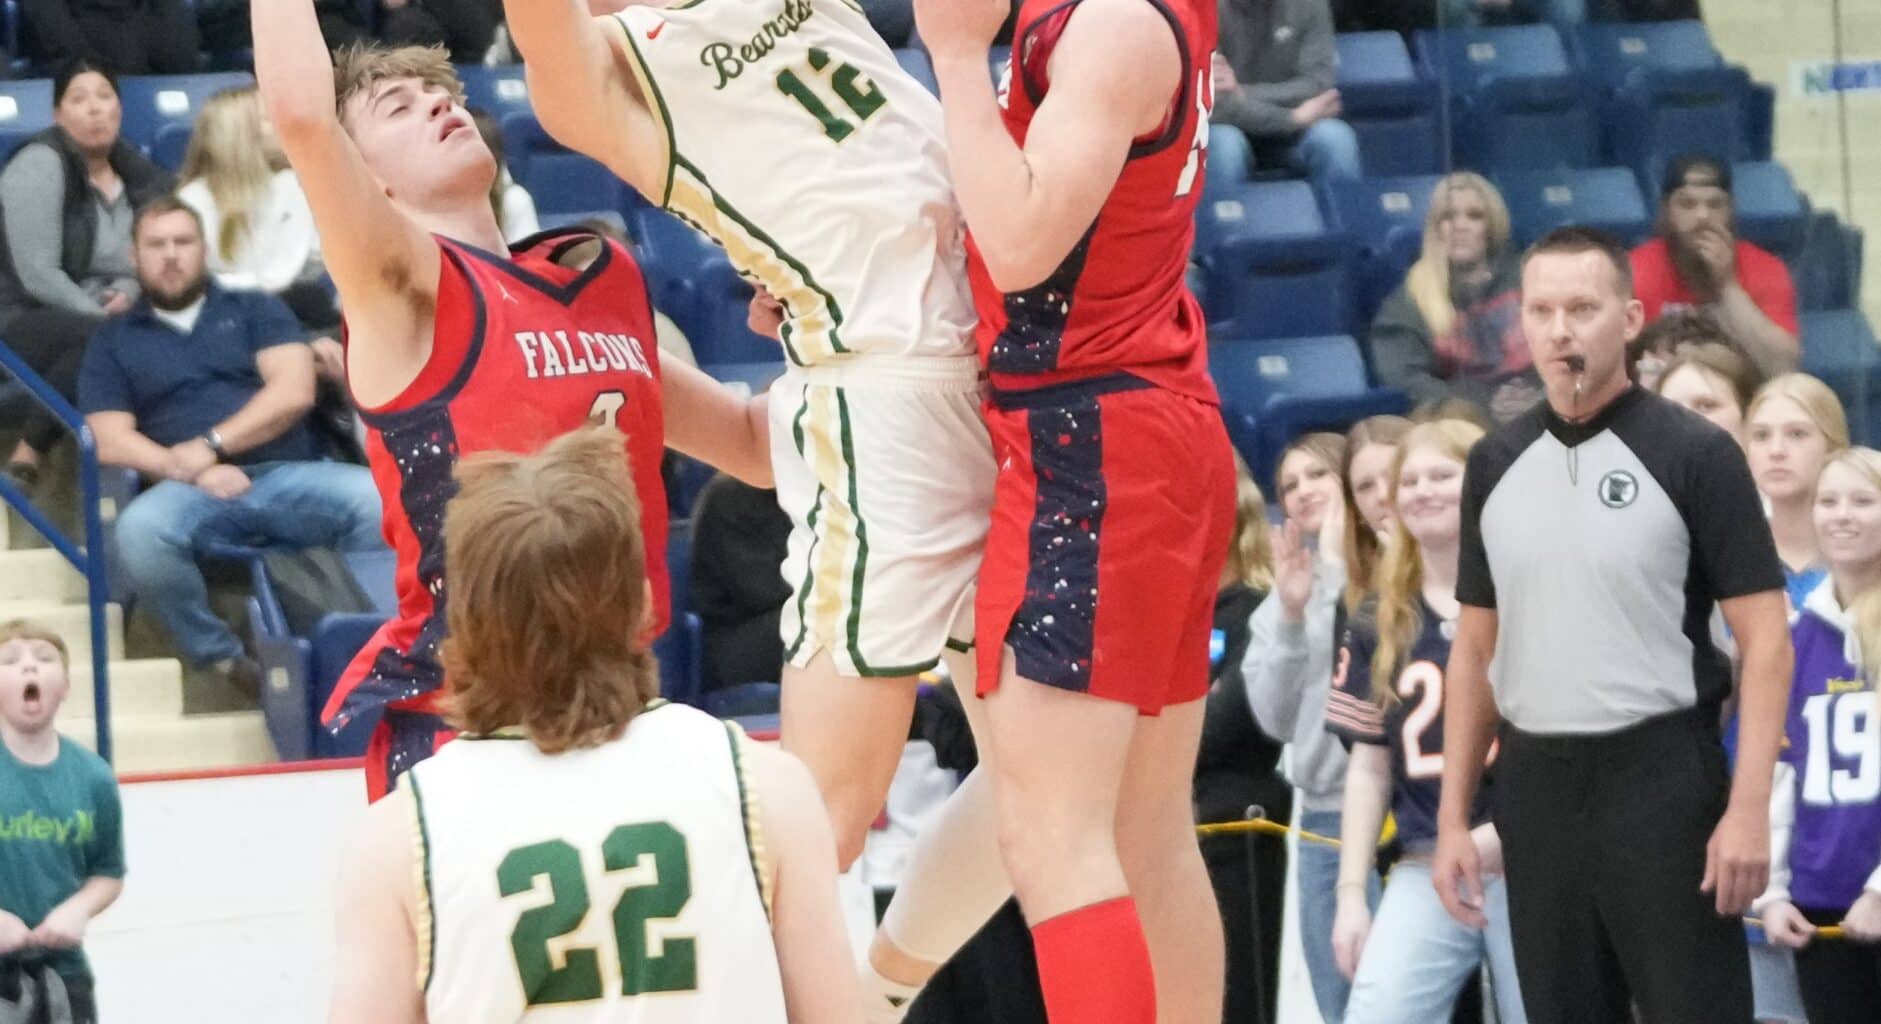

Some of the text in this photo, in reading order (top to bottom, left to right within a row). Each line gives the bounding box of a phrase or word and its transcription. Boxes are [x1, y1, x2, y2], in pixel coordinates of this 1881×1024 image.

[775, 47, 887, 142] 12
[514, 330, 653, 379] FALCONS
[1801, 691, 1881, 804] 19
[496, 820, 698, 1007] 22
